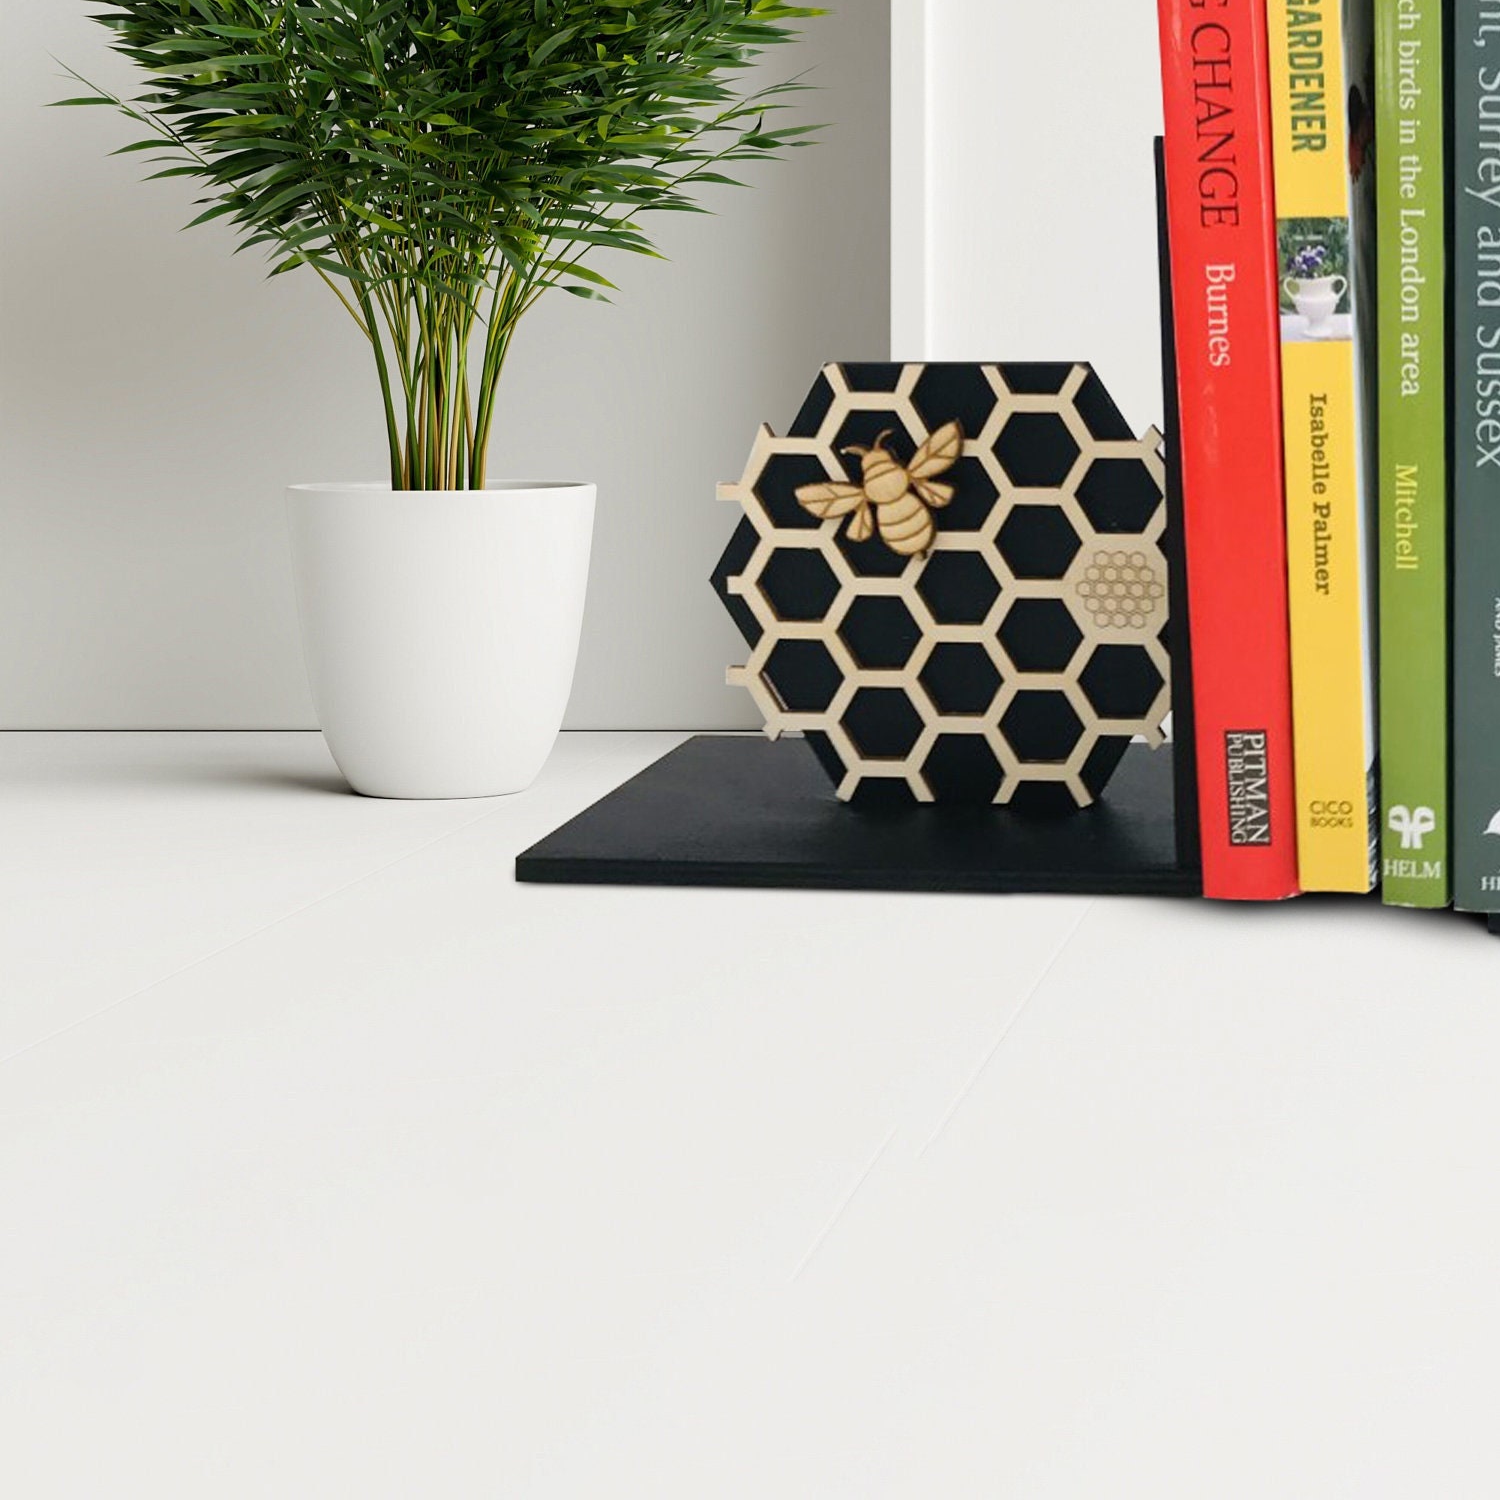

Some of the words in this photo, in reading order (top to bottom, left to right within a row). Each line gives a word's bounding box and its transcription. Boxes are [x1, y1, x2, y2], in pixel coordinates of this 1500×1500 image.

[1398, 40, 1422, 110] birds
[1190, 22, 1240, 228] CHANGE
[1399, 119, 1421, 144] in
[1399, 154, 1423, 199] the
[1400, 208, 1426, 322] London
[1205, 264, 1236, 367] Burnes
[1400, 332, 1420, 397] area
[1309, 393, 1330, 495] Isabelle
[1312, 501, 1332, 596] Palmer
[1395, 464, 1419, 569] Mitchell
[1226, 733, 1247, 844] PUBLISHING
[1242, 733, 1270, 843] PITMAN
[1309, 800, 1353, 815] CICO
[1310, 817, 1353, 828] BOOKS
[1383, 859, 1441, 879] HELM
